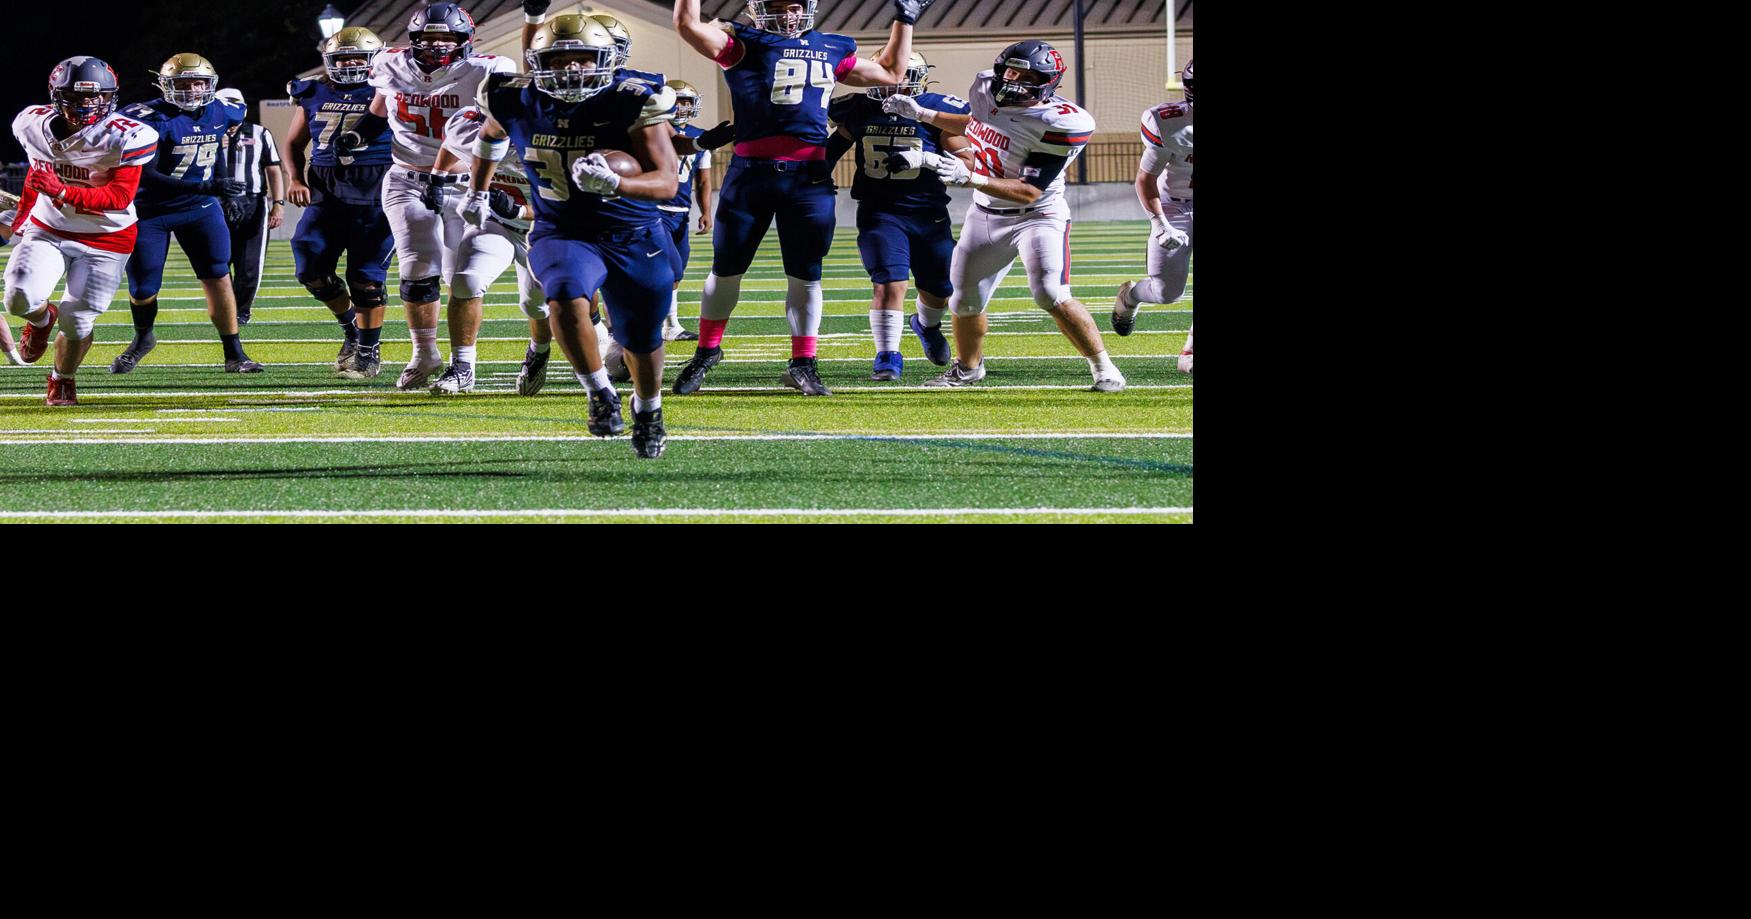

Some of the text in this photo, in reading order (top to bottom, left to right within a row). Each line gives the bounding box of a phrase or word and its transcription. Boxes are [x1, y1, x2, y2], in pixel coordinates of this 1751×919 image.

[783, 48, 828, 61] GRIZZLIES
[771, 59, 835, 109] 84
[321, 102, 367, 112] GRIZZLIES
[395, 92, 460, 109] REDWOOD
[865, 124, 916, 135] GRIZZLIES
[181, 134, 217, 144] GRIZZLIES
[531, 133, 596, 149] GRIZZLIES
[171, 142, 219, 181] 79
